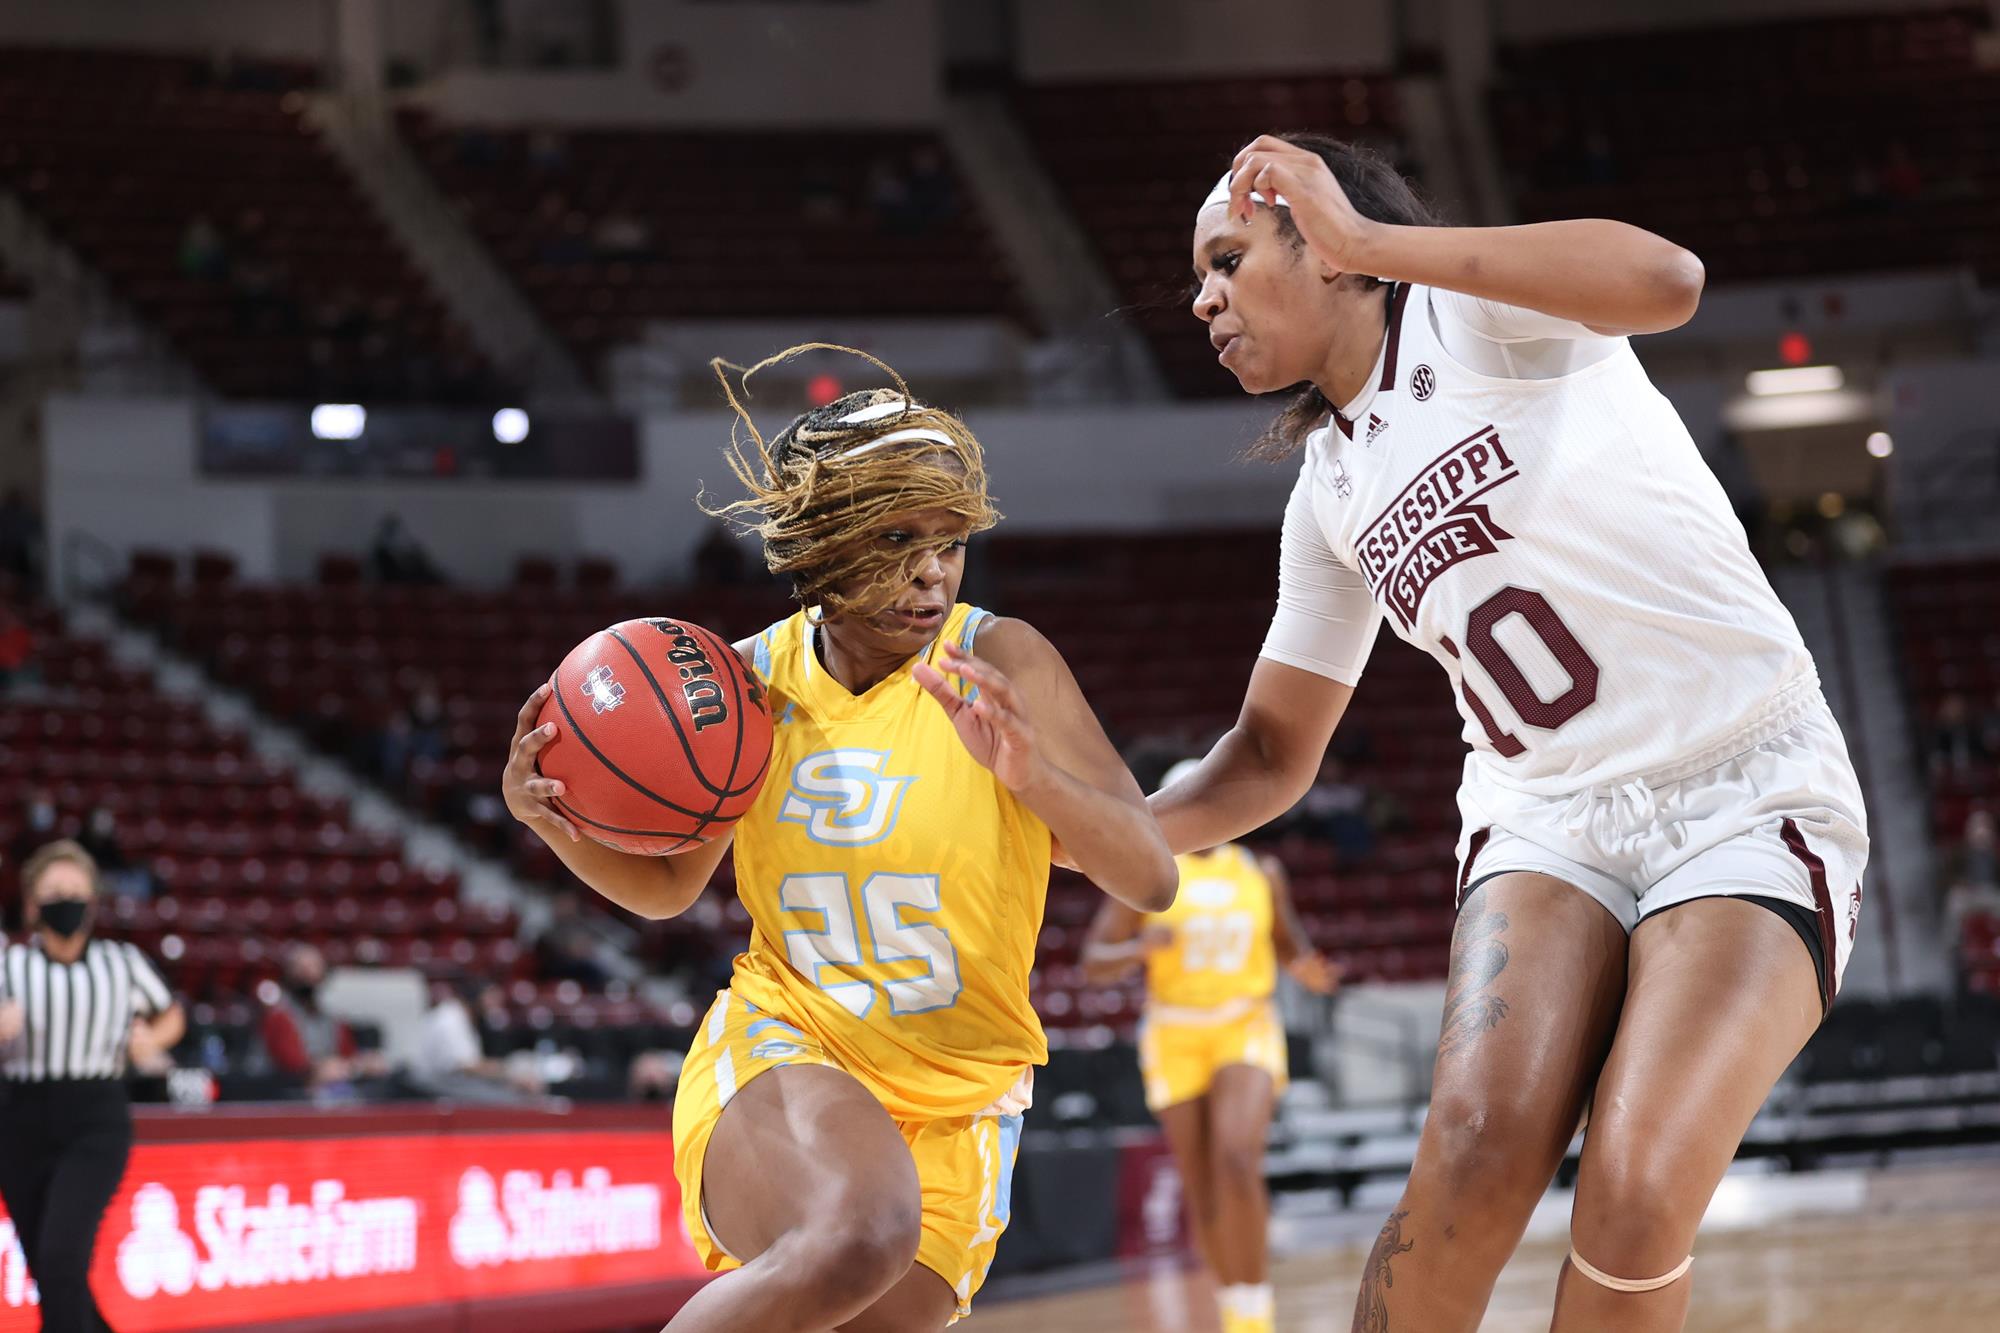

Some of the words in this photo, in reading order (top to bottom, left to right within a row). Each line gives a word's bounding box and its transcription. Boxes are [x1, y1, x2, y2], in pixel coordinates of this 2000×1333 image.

[1412, 366, 1434, 399] SEC
[1397, 524, 1481, 609] STATE
[1437, 583, 1602, 759] 10
[776, 747, 919, 848] SU
[779, 871, 964, 1021] 25
